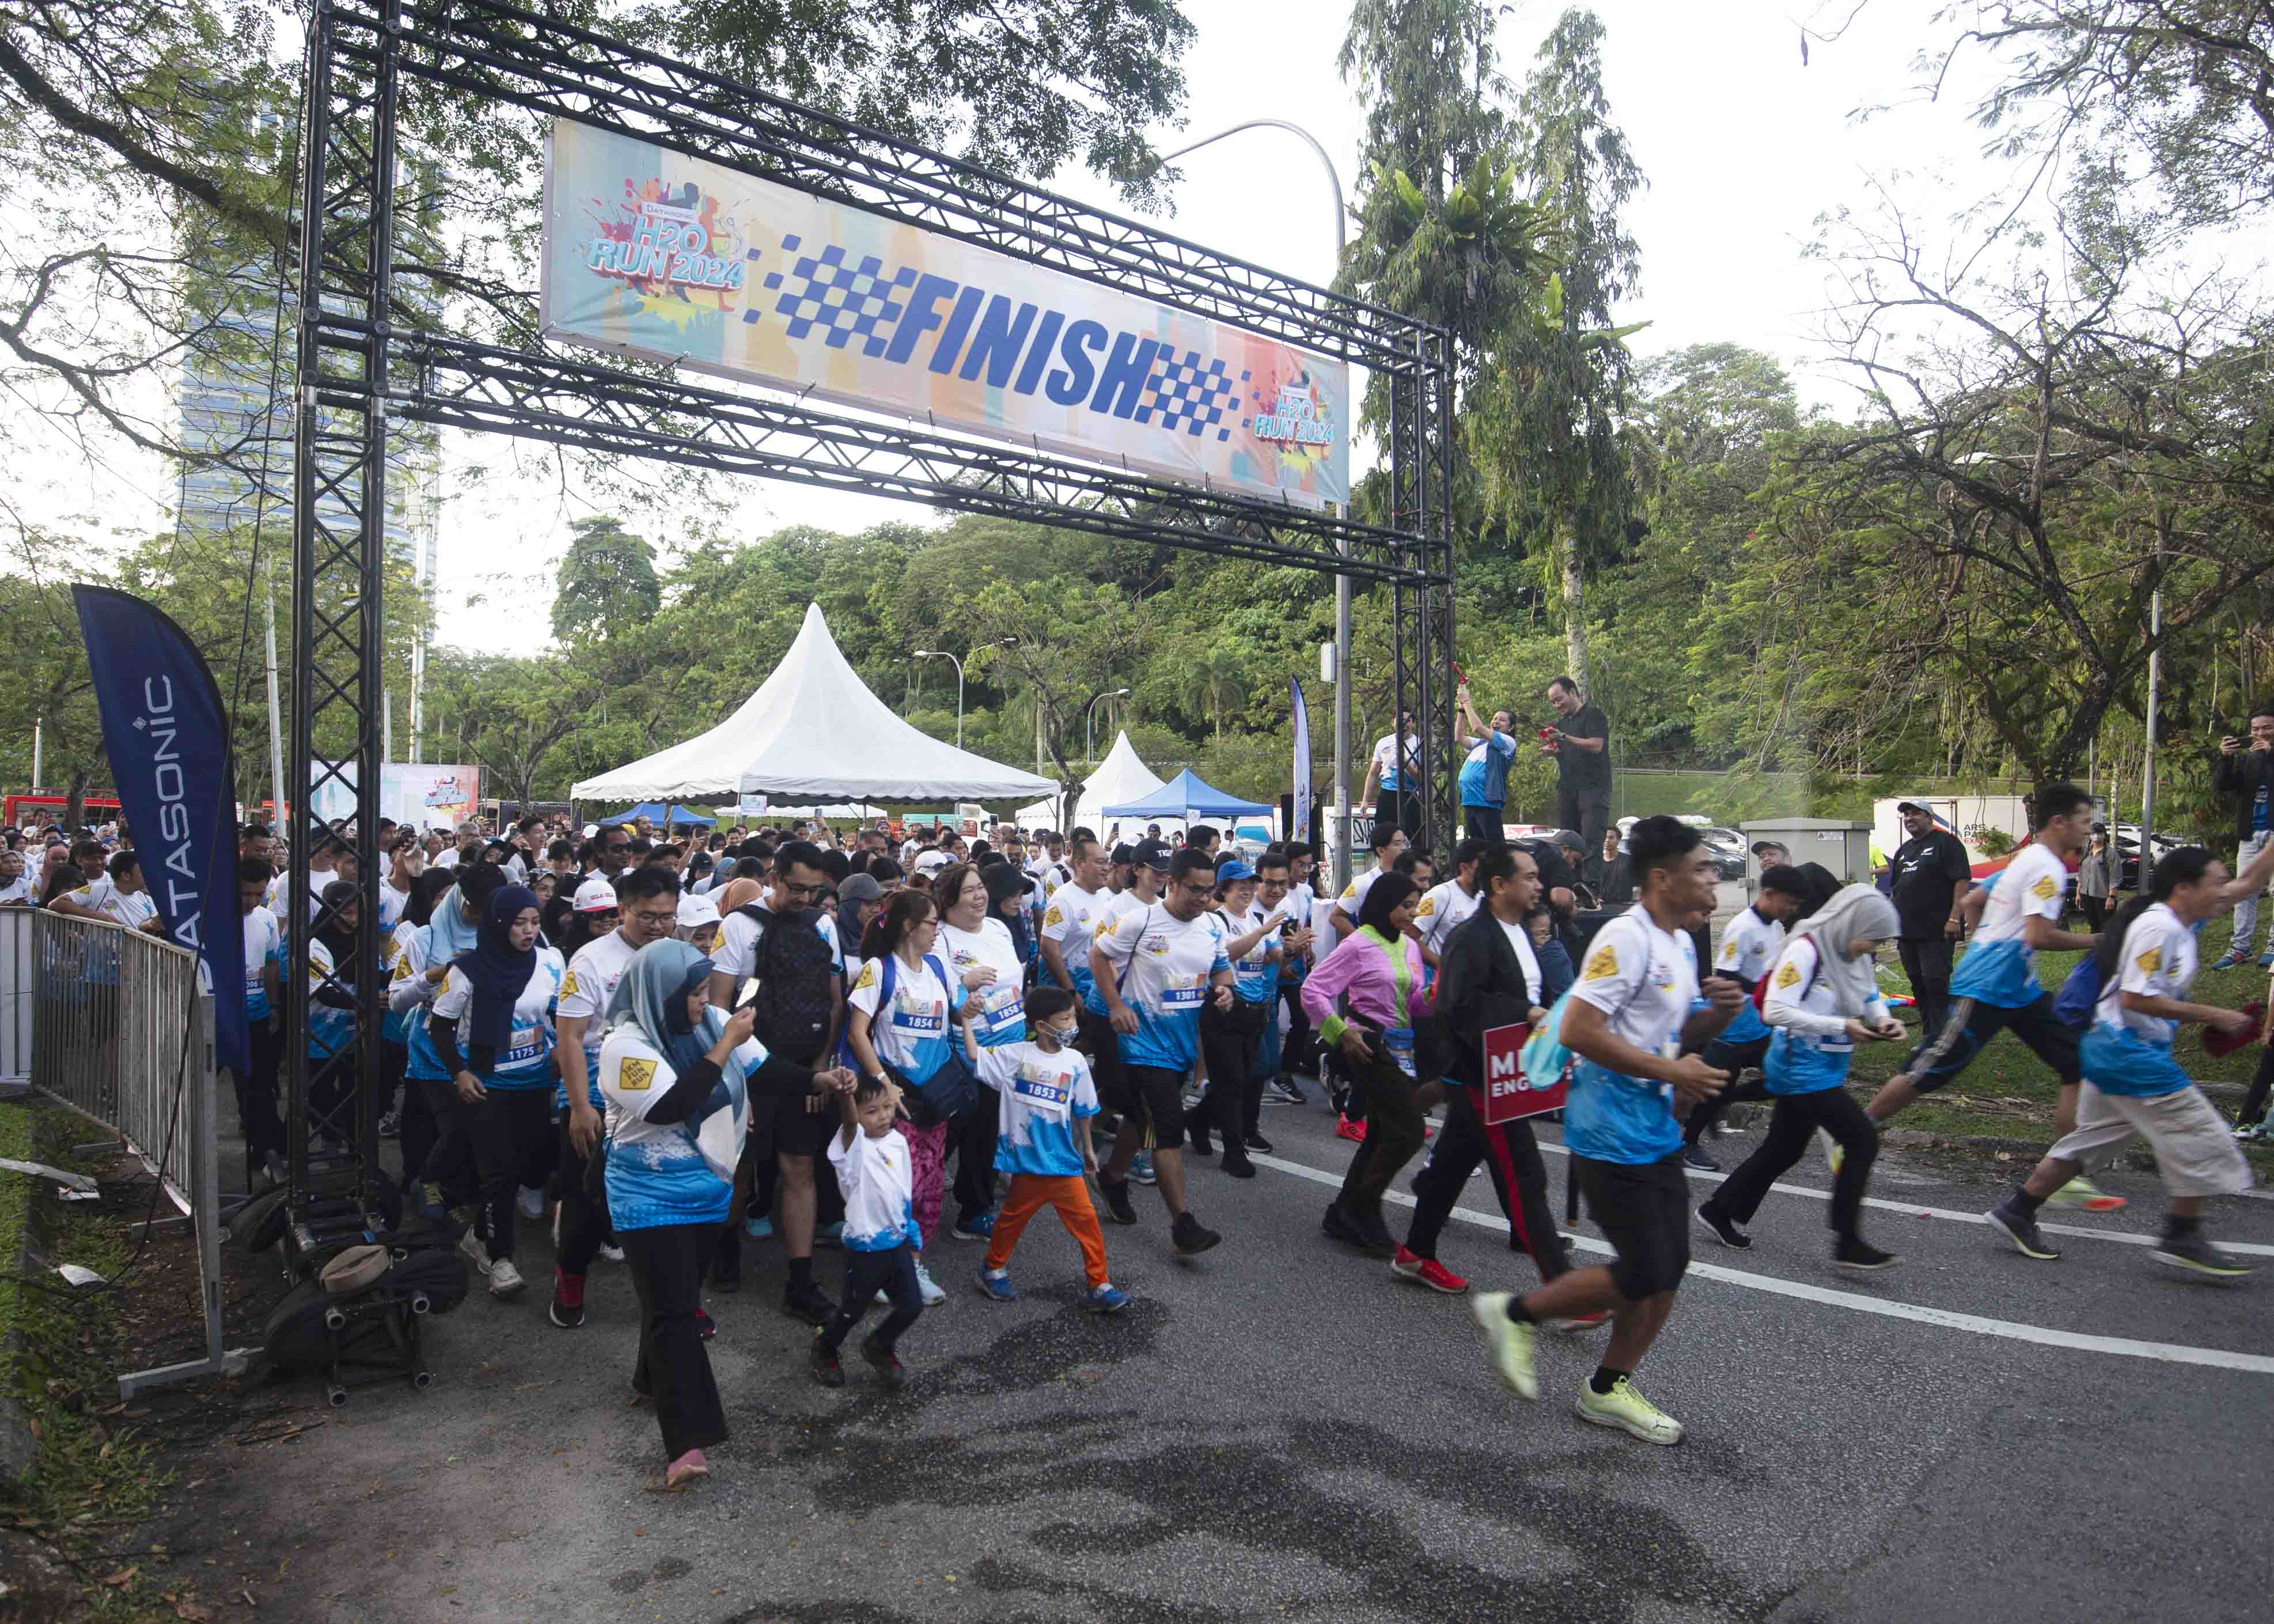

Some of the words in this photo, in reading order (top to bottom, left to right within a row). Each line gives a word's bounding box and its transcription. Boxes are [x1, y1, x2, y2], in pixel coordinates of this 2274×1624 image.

[633, 215, 708, 256] H2O
[588, 238, 668, 281] RUN
[670, 252, 746, 289] 2024
[884, 273, 1160, 419] FINISH
[1276, 396, 1314, 422] H2O
[1253, 413, 1296, 441] RUN
[1296, 422, 1335, 445] 2024
[908, 1016, 933, 1028] 1854
[508, 1046, 535, 1060] 1175
[1028, 1084, 1056, 1099] 1853
